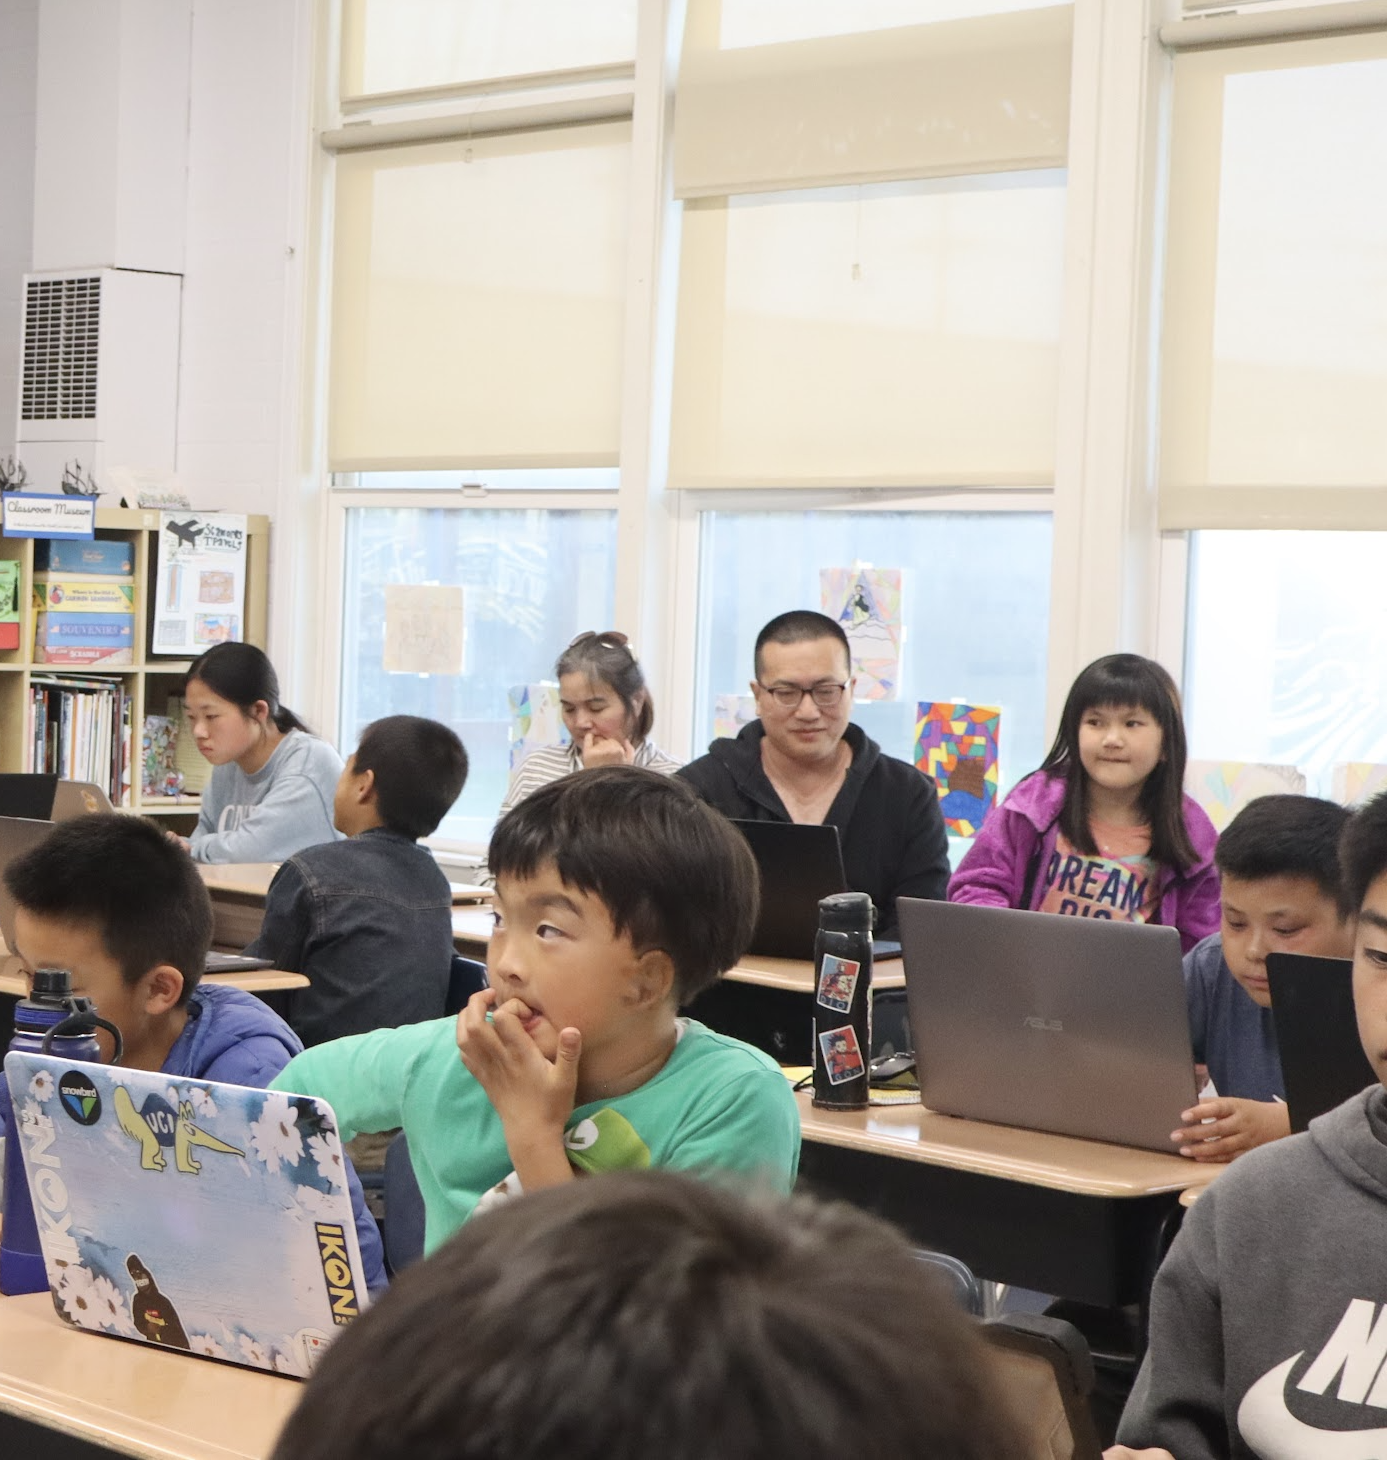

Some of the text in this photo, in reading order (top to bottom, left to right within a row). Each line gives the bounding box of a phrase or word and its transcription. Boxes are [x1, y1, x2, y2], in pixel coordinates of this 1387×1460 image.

[7, 501, 91, 516] Classroom Museum
[61, 624, 119, 635] SOUVENIRS
[1046, 849, 1149, 911] DREAM
[61, 1086, 97, 1098] snowbird
[146, 1110, 175, 1135] UCI
[316, 1224, 360, 1316] IKON
